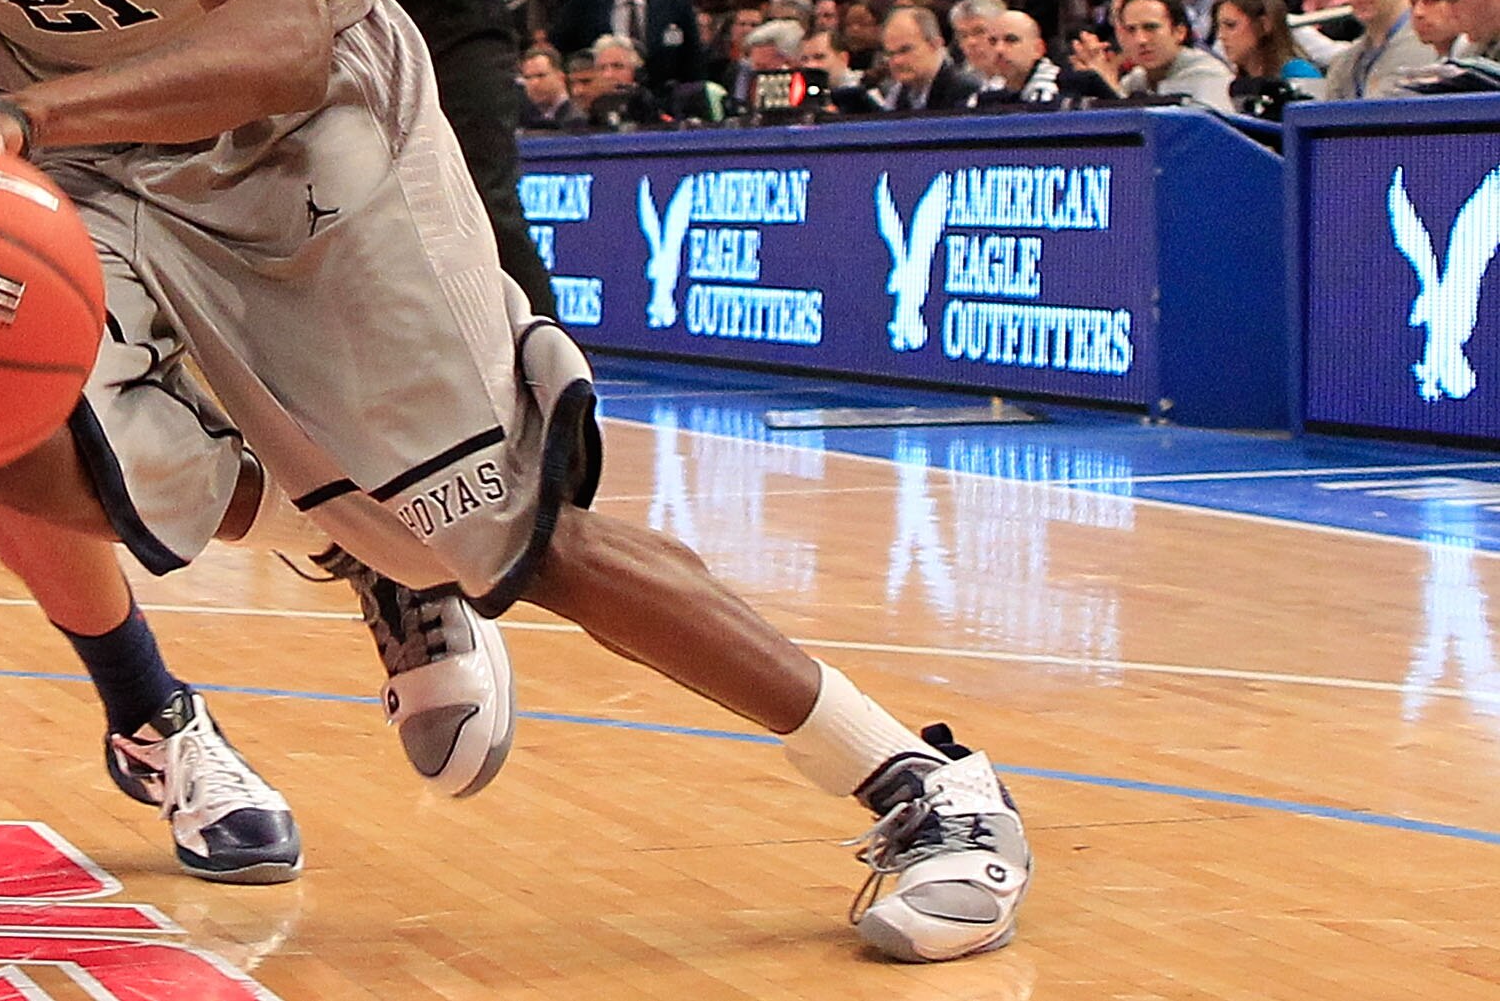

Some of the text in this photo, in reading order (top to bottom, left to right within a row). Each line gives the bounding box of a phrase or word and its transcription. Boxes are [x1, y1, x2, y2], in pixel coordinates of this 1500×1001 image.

[689, 168, 811, 223] AMERICAN
[947, 165, 1111, 230] AMERICAN
[688, 228, 761, 281] EAGLE
[944, 233, 1042, 297] EAGLE
[685, 284, 823, 344] OUTFITTERS
[942, 299, 1133, 376] OUTFITTERS
